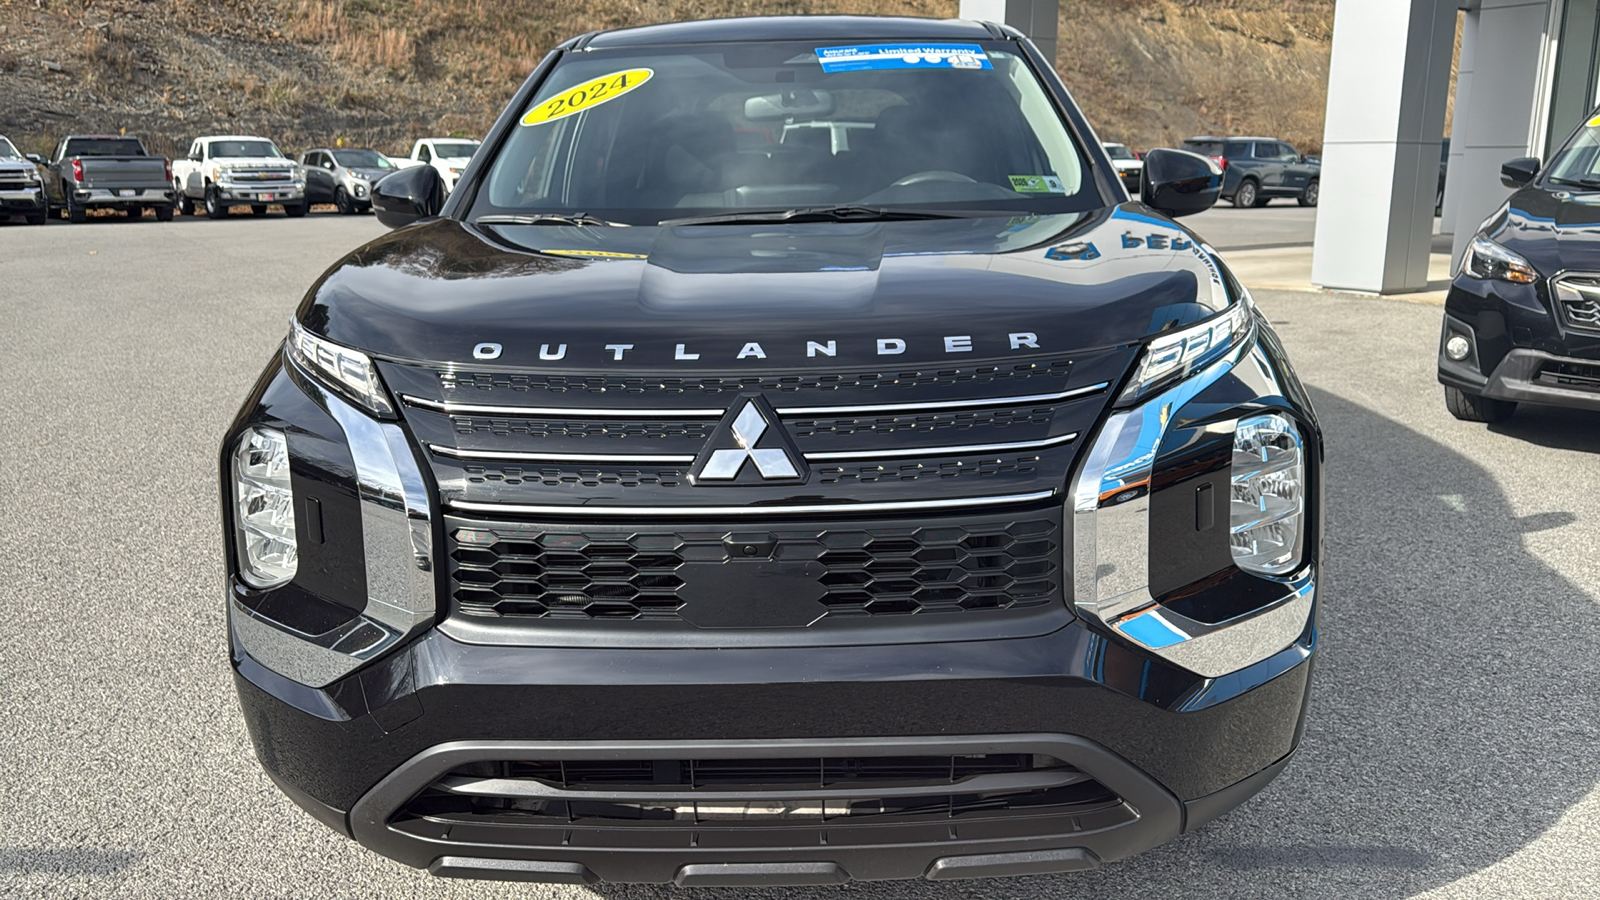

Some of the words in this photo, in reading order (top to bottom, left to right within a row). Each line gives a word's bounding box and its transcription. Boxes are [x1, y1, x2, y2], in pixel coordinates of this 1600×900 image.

[922, 47, 976, 55] Warranty
[547, 73, 632, 118] 2024
[472, 332, 1041, 361] OUTLANDER
